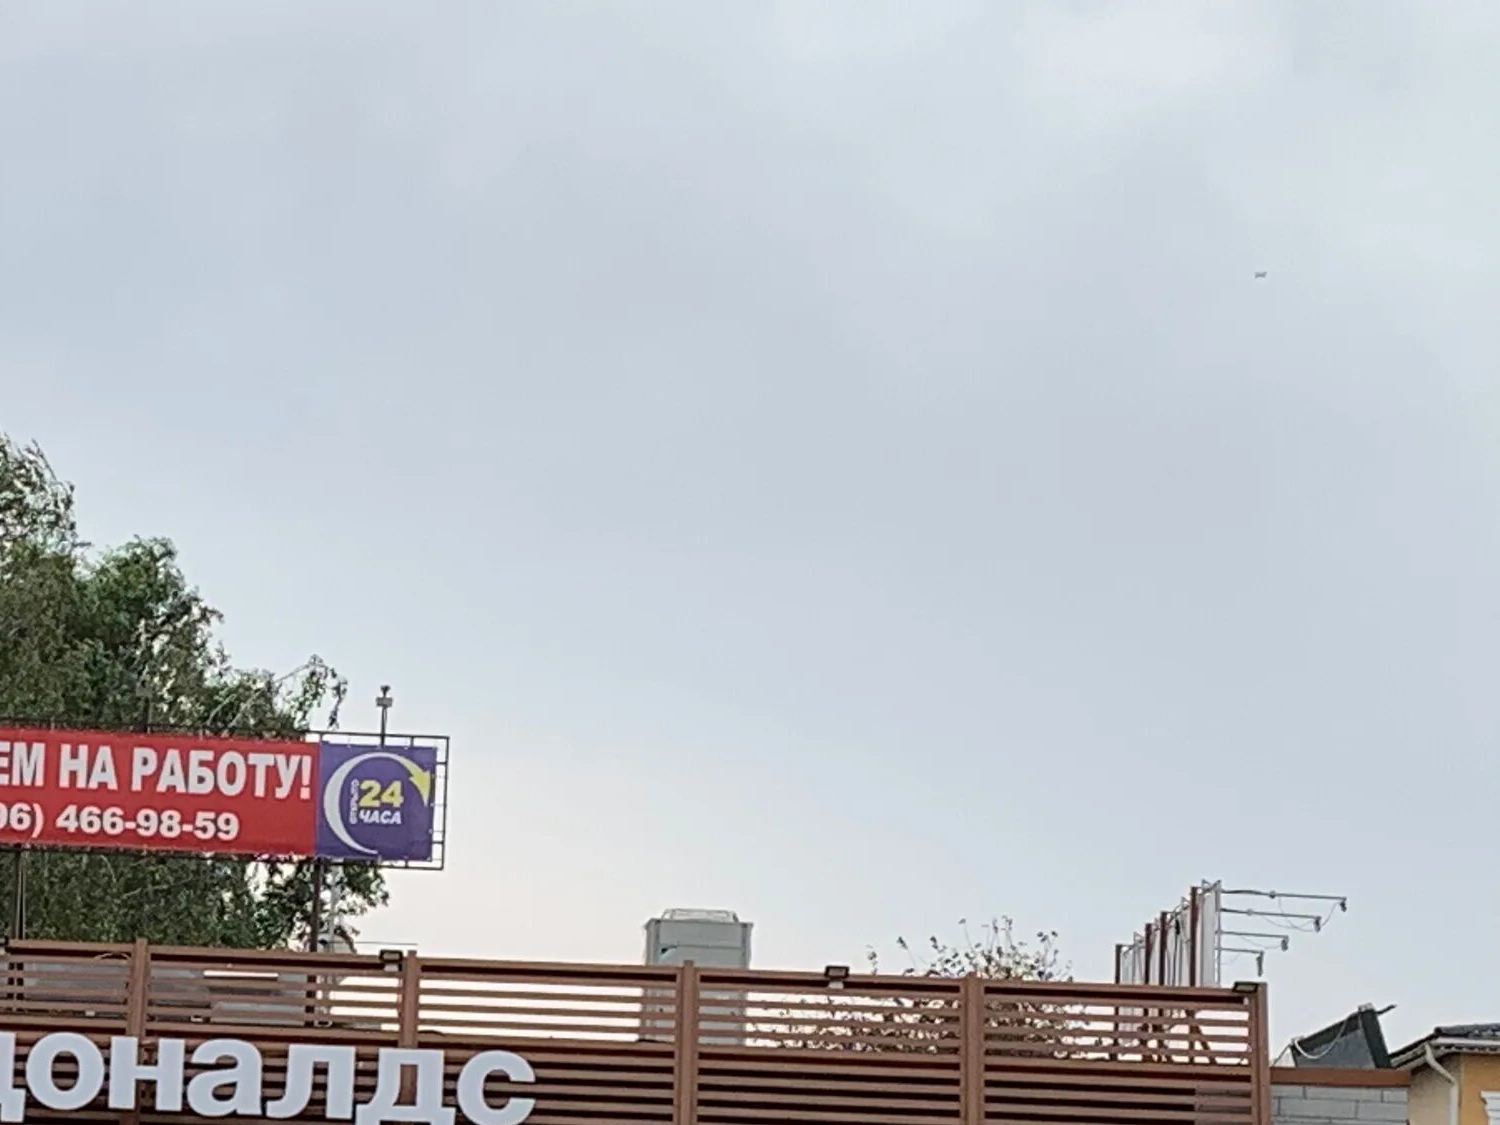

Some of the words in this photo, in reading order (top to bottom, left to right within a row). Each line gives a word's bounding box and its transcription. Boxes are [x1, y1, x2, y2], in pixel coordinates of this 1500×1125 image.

[59, 743, 119, 791] НА
[131, 747, 312, 800] РАБОТУ!
[358, 780, 404, 808] 24
[55, 804, 240, 841] 466-98-59
[358, 810, 402, 825] ЧАСА
